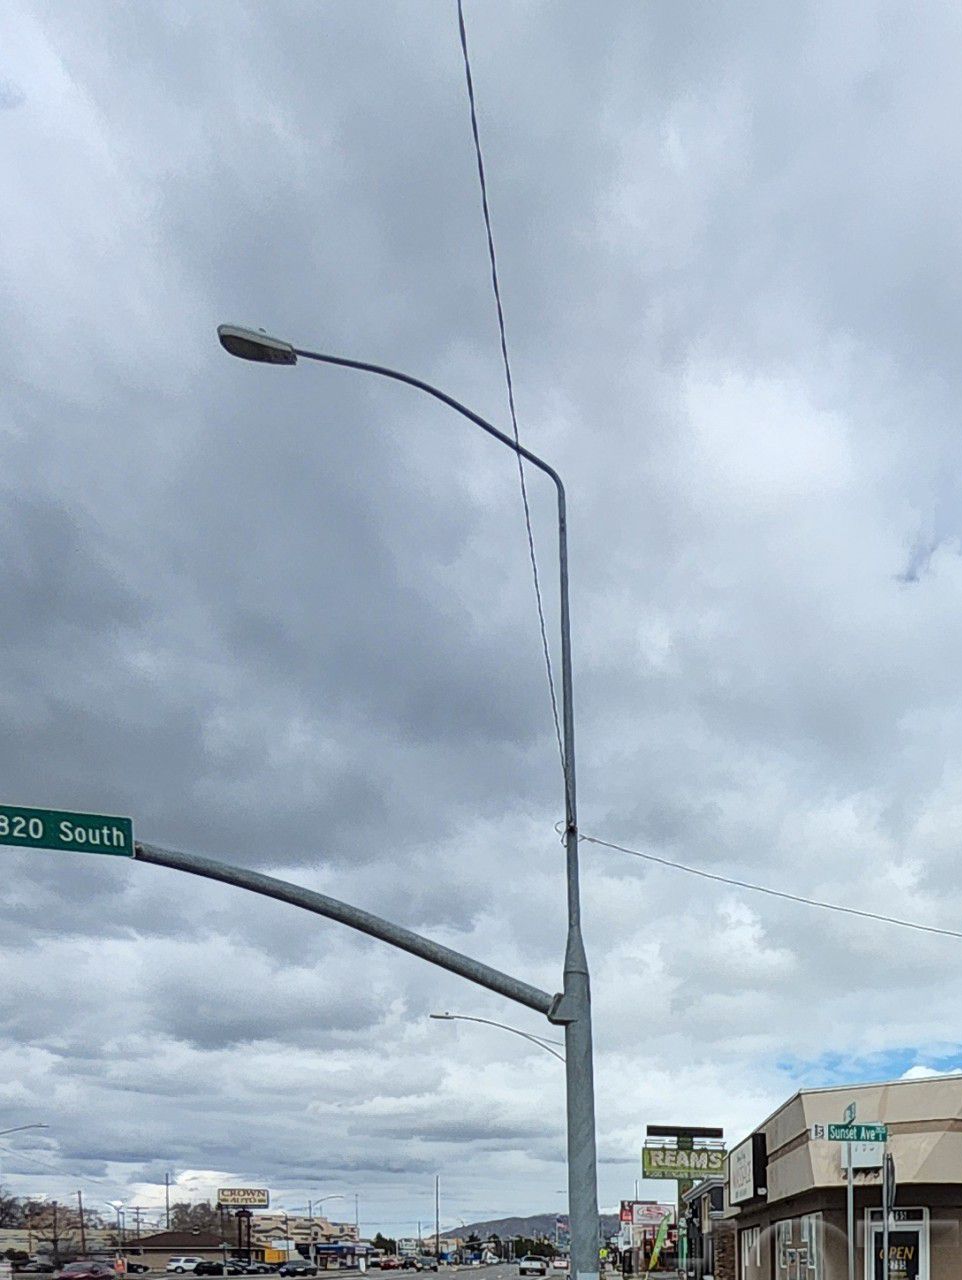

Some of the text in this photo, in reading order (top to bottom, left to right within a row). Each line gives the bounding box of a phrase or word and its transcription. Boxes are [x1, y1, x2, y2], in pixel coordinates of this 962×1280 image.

[59, 821, 125, 847] South
[830, 1125, 857, 1139] Sunset
[860, 1126, 875, 1140] Ave
